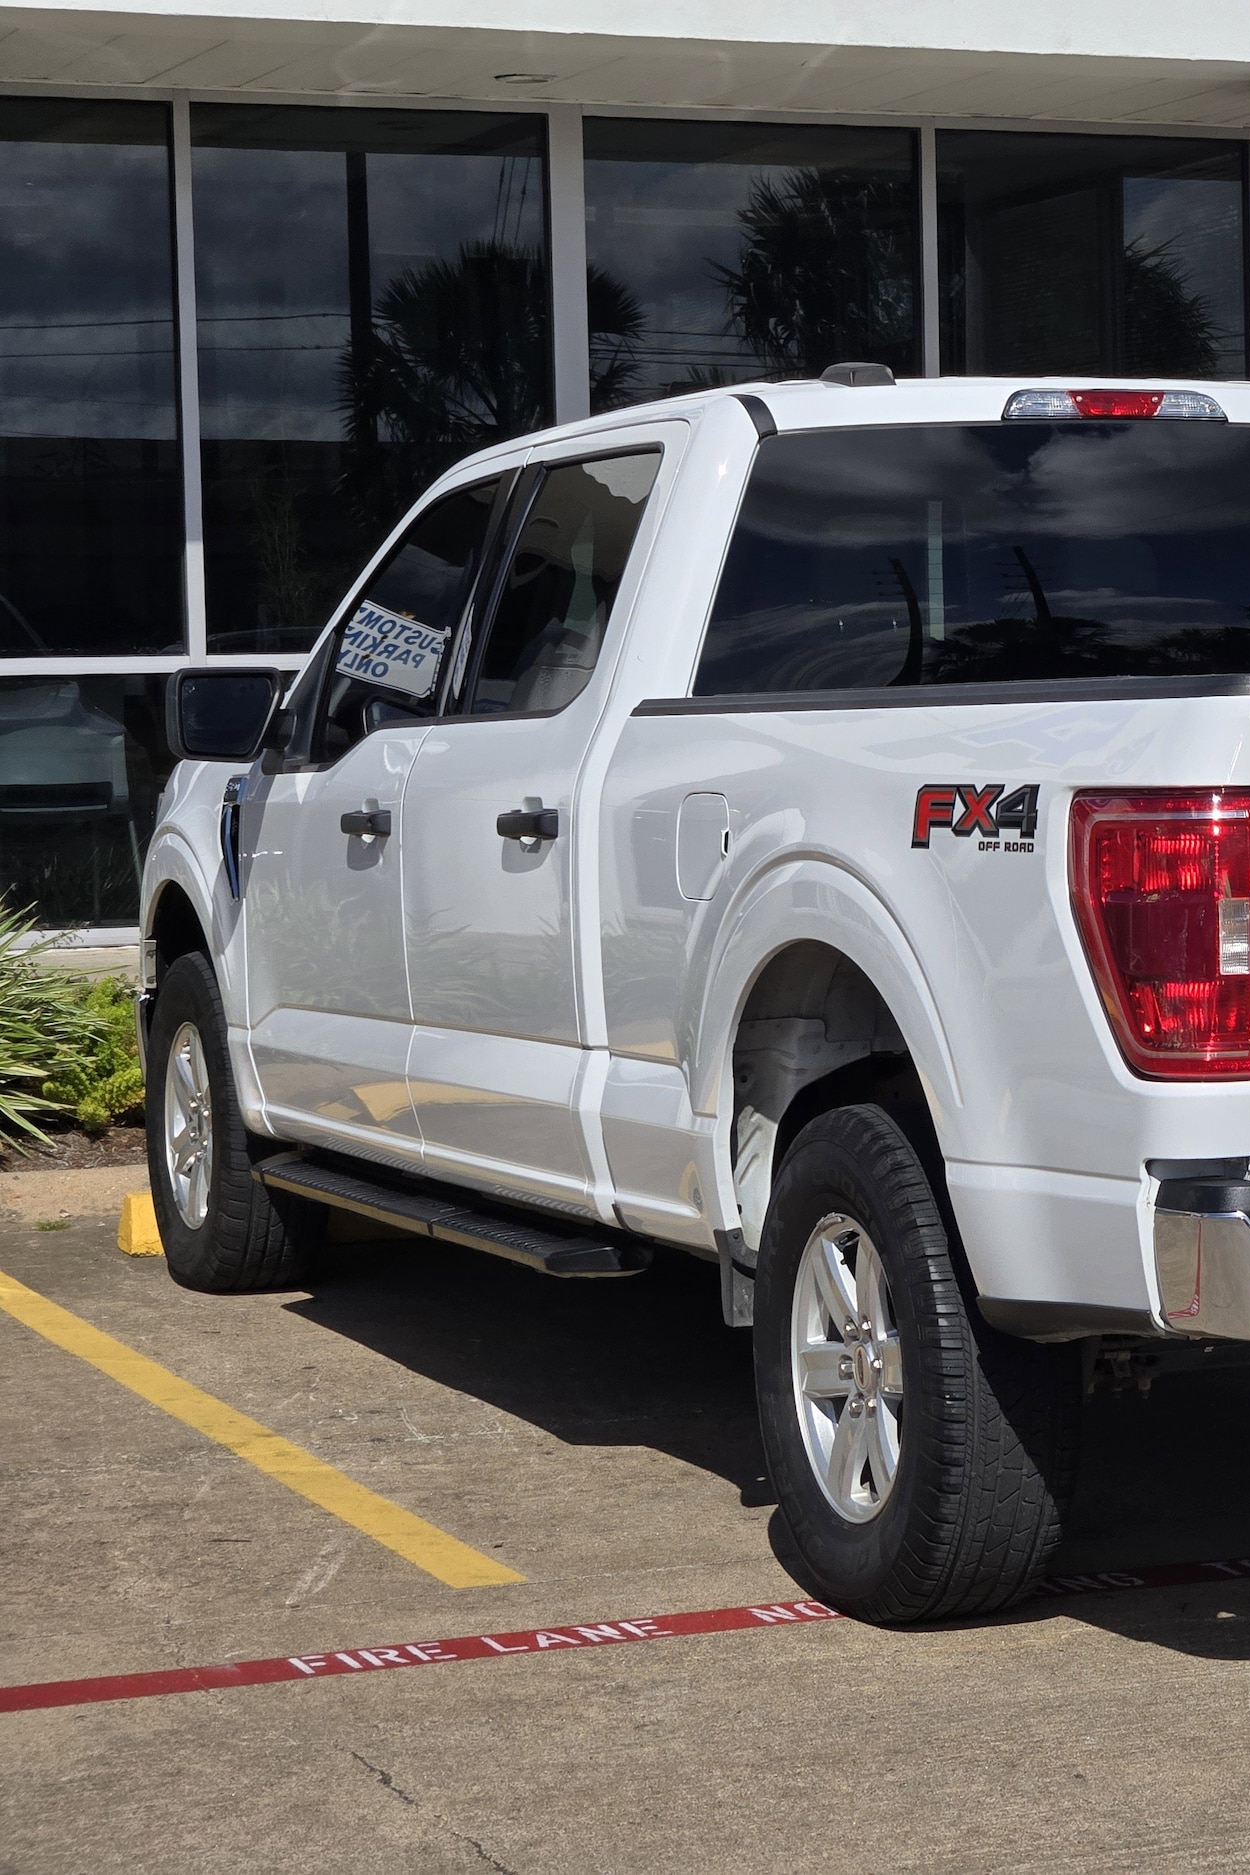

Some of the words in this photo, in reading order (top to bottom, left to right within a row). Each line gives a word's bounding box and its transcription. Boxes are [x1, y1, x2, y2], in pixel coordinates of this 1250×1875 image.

[911, 783, 1040, 849] FX4
[978, 841, 1000, 852] OFF
[1004, 841, 1034, 853] ROAD
[288, 1641, 458, 1675] FIRE
[481, 1619, 674, 1653] LANE
[747, 1601, 840, 1623] NO
